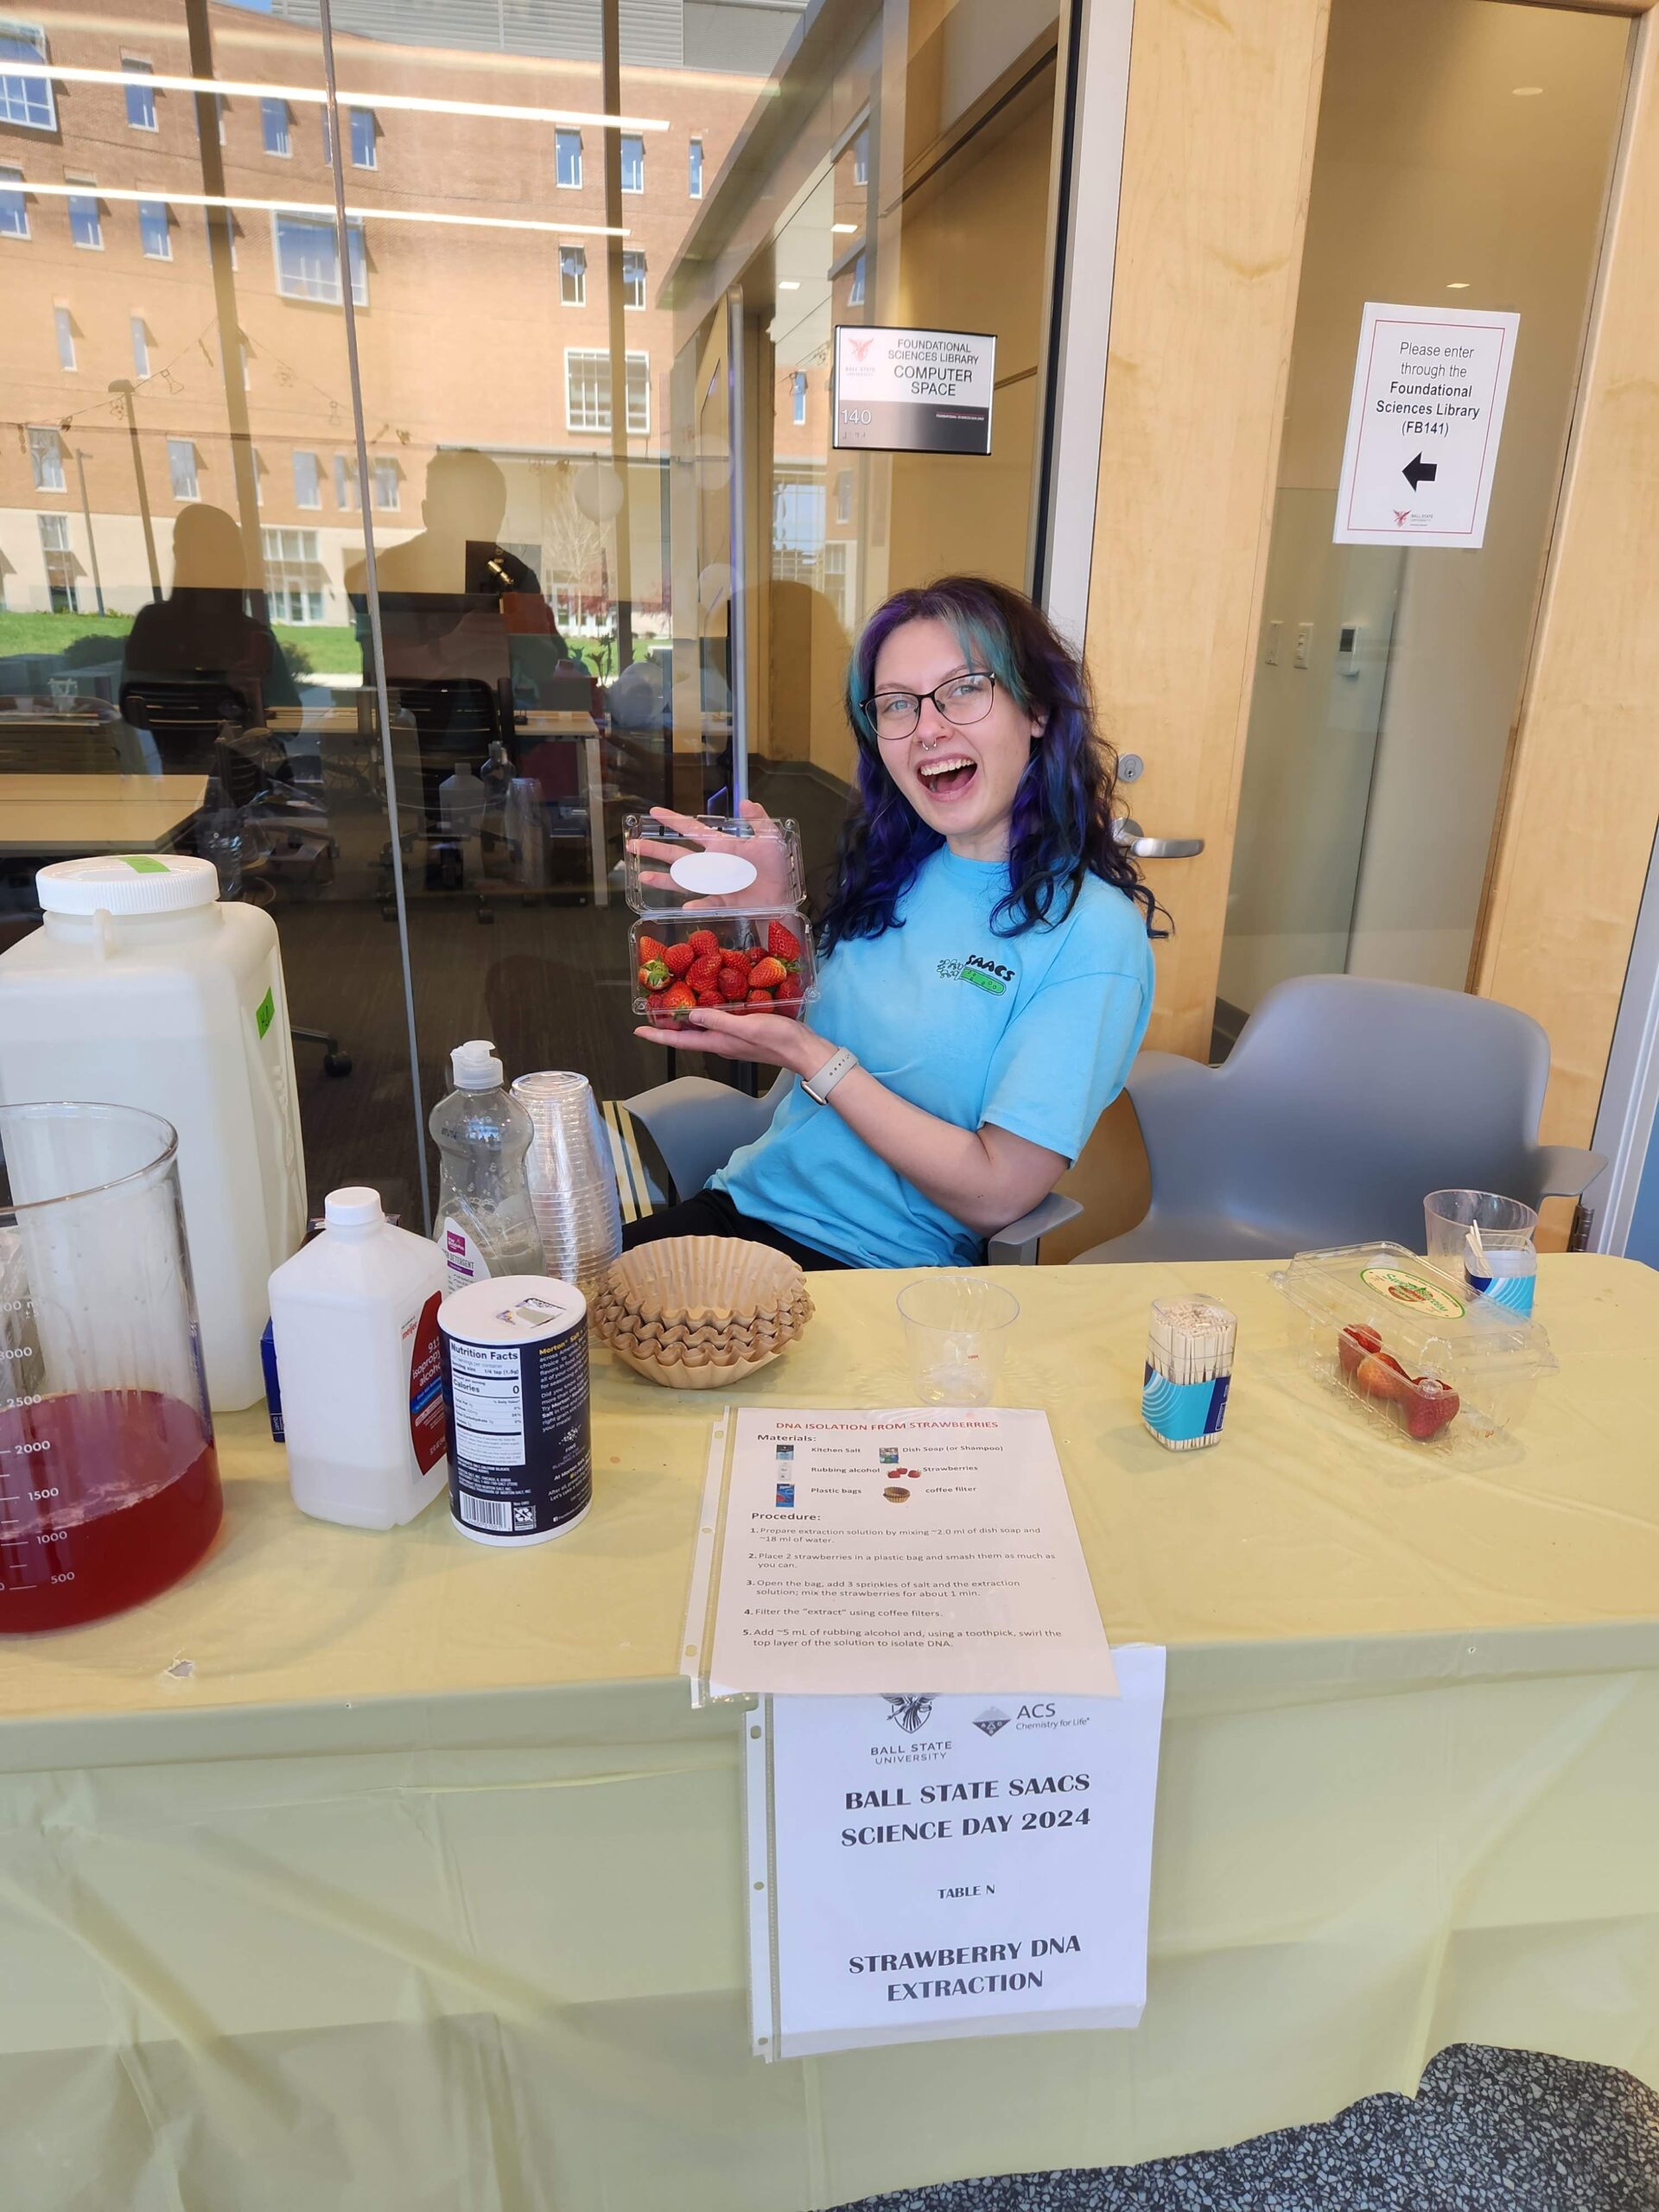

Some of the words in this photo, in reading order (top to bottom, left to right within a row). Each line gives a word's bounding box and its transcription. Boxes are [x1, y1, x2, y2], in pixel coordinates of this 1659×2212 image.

[898, 339, 970, 353] FOUNDATIONAL
[1400, 341, 1440, 357] Please
[1445, 346, 1474, 359] enter
[888, 351, 937, 361] SCIENCES
[940, 353, 979, 365] LIBRARY
[894, 365, 972, 382] COMPUTER
[1401, 362, 1445, 379] through
[1449, 365, 1466, 378] the
[911, 382, 956, 397] SPACE
[1389, 381, 1471, 397] Foundational
[841, 410, 872, 425] 140
[1376, 400, 1432, 415] Sciences
[1437, 404, 1479, 420] Library
[1402, 421, 1448, 437] (FB141)
[966, 955, 1015, 982] SAACS
[451, 1342, 487, 1359] Nutrition
[491, 1351, 518, 1360] Facts
[454, 1379, 480, 1392] Calories
[7, 1395, 41, 1408] 2500
[16, 1441, 51, 1455] 2000
[28, 1488, 59, 1502] 1500
[36, 1531, 67, 1545] 1000
[50, 1572, 75, 1585] 500
[1017, 1703, 1056, 1719] ACS
[1016, 1719, 1057, 1731] Chemistry
[1060, 1719, 1071, 1728] for
[871, 1745, 905, 1755] BALL
[912, 1741, 951, 1752] STATE
[875, 1752, 947, 1764] UNIVERSITY
[846, 1789, 911, 1810] BALL
[920, 1781, 999, 1804] STATE
[1009, 1774, 1090, 1796] SAACS
[842, 1821, 952, 1847] SCIENCE
[963, 1815, 1013, 1836] DAY
[1022, 1808, 1090, 1830] 2024
[938, 1885, 981, 1899] TABLE
[986, 1885, 995, 1894] N
[849, 1942, 1022, 1974] STRAWBERRY
[1032, 1935, 1081, 1957] DNA
[888, 1970, 1042, 2002] EXTRACTION
